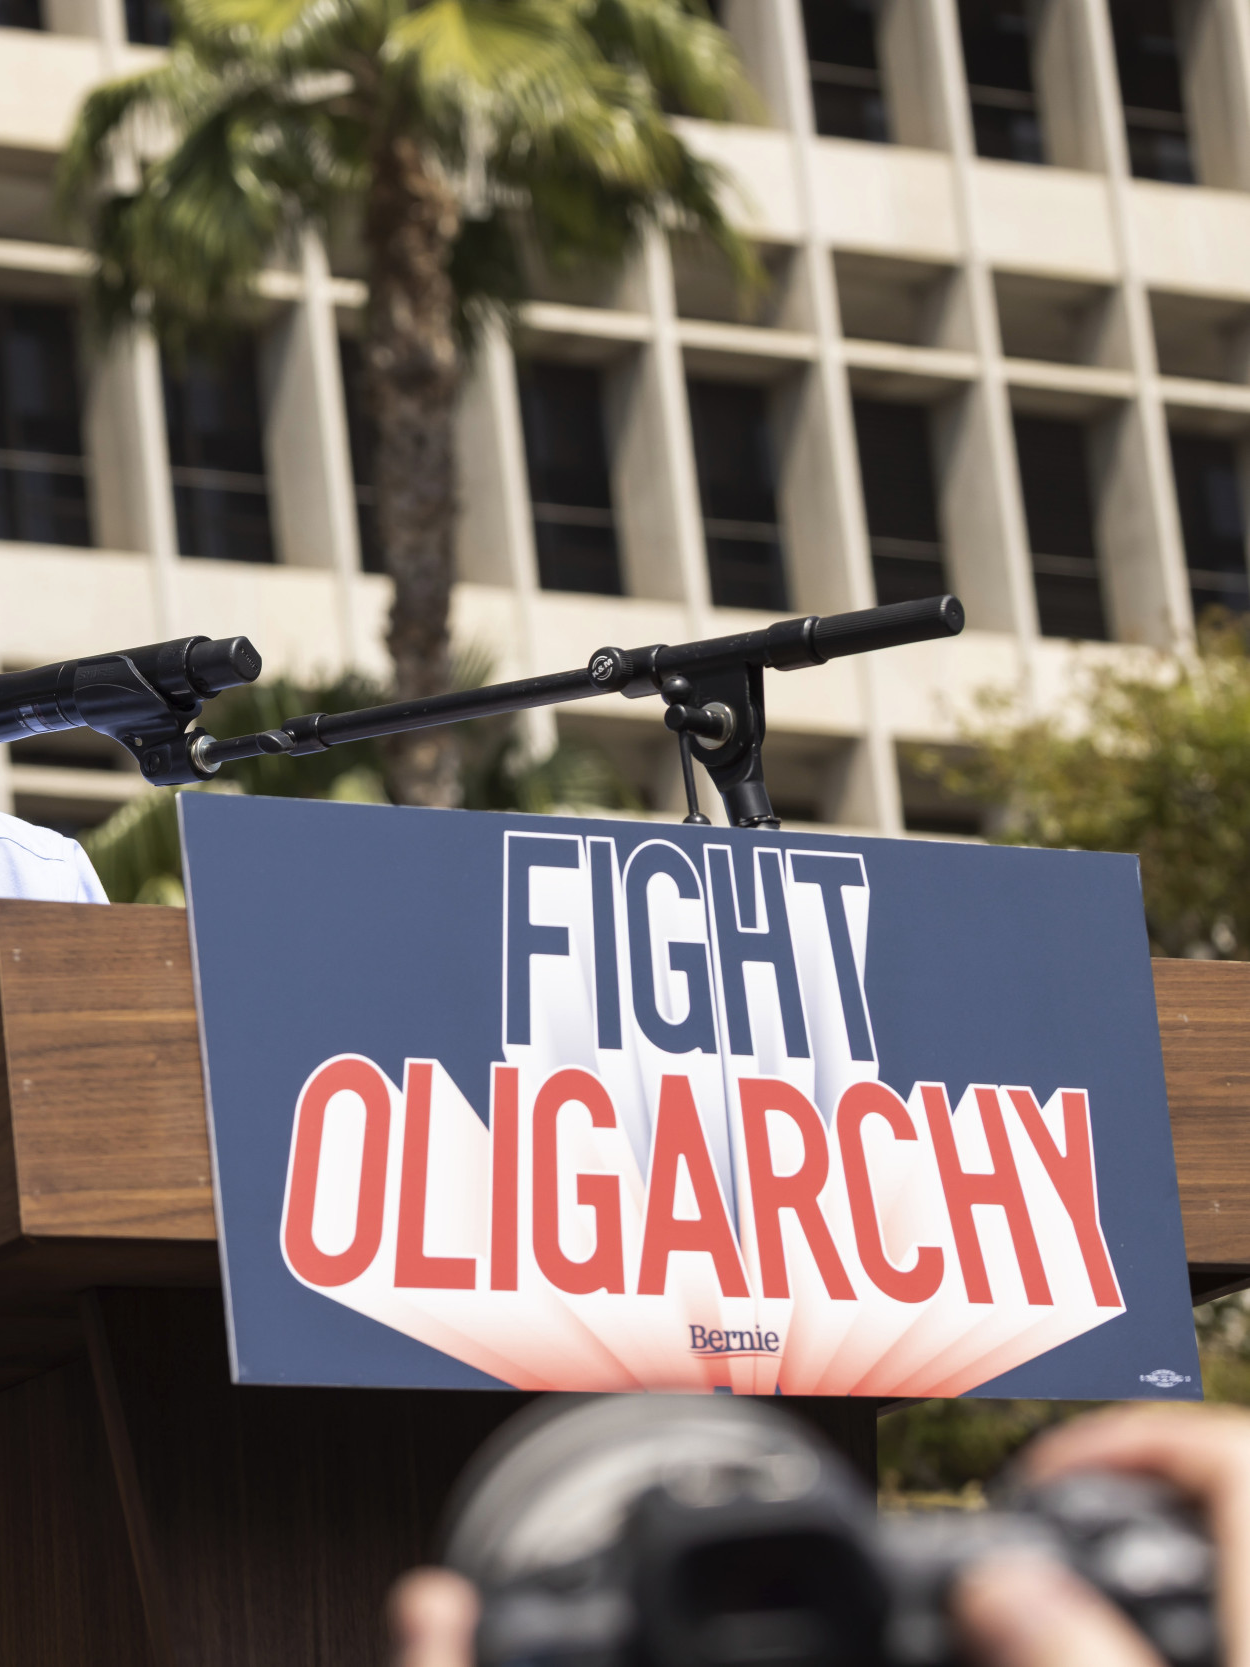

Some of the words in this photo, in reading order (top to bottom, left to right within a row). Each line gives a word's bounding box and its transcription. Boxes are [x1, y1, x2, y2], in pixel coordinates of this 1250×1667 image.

[592, 658, 613, 678] K&M
[502, 830, 876, 1064] FIGHT
[281, 1054, 1124, 1308] OLIGARCHY
[688, 1324, 780, 1353] Bernie
